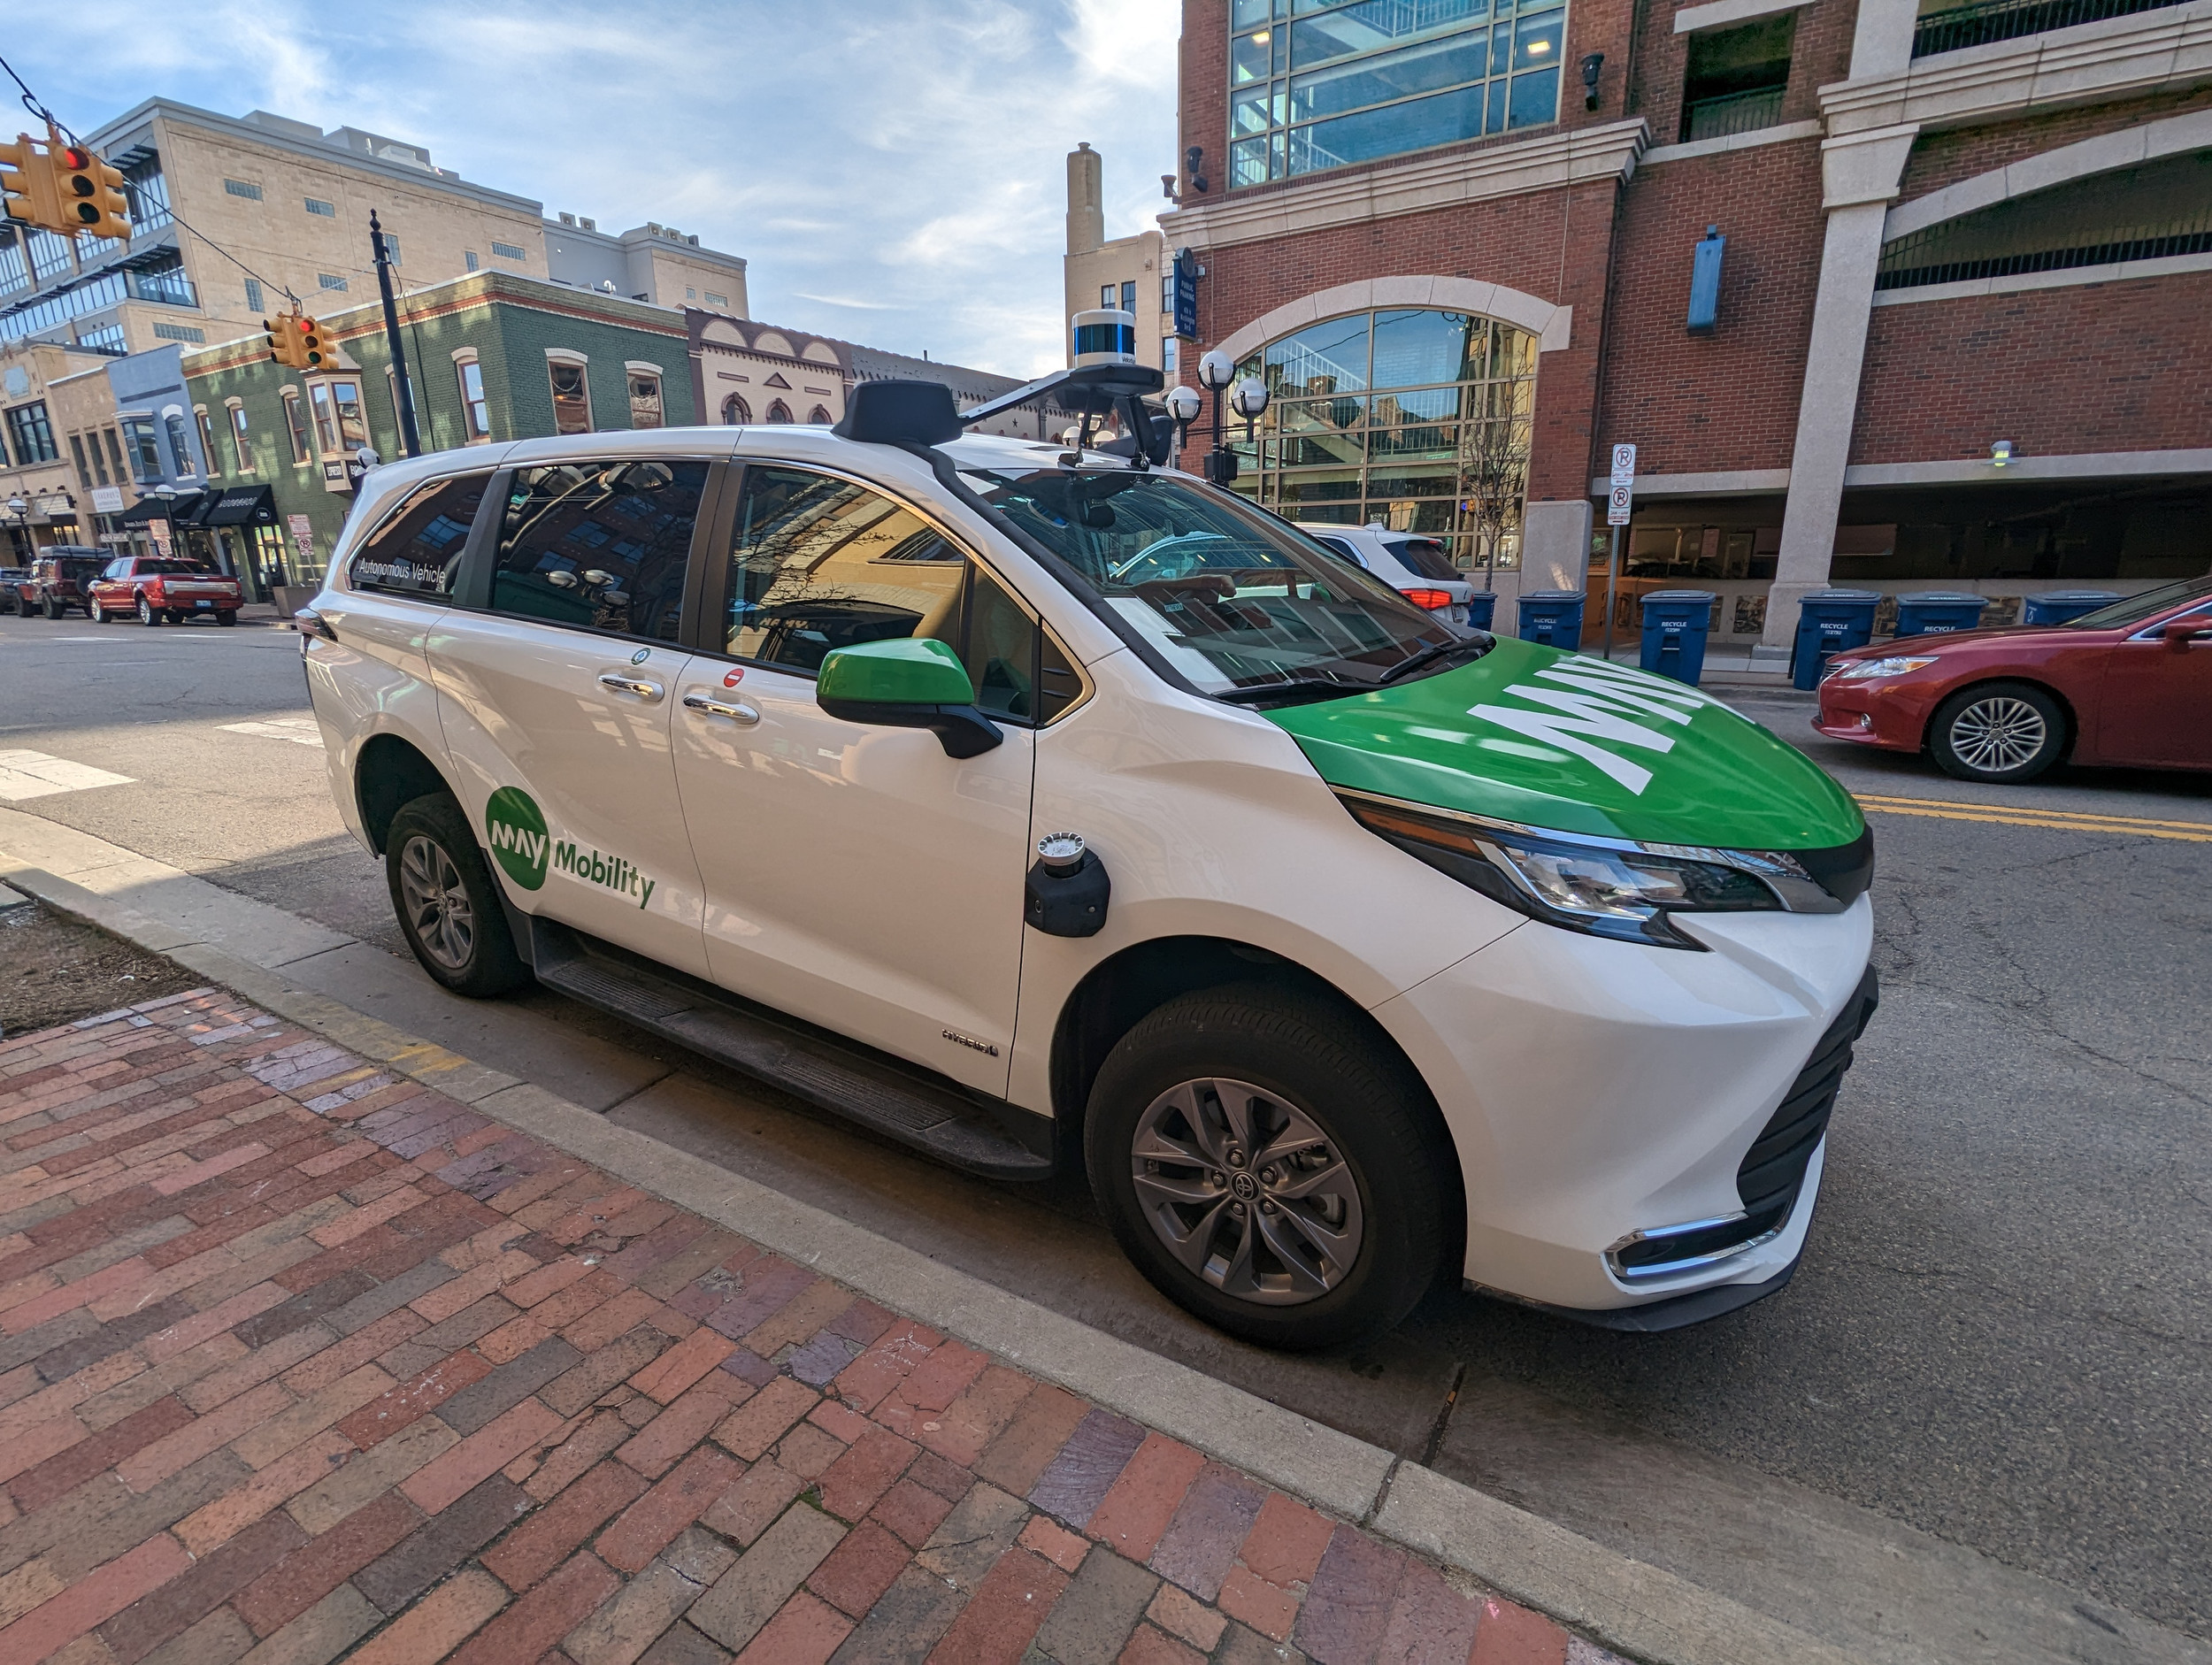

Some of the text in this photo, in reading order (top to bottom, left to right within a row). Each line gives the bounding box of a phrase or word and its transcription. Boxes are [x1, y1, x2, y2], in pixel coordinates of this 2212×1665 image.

[359, 556, 446, 583] Autonomous Vehicle
[491, 819, 656, 910] MAY Mobility
[942, 1028, 988, 1054] HYBRID
